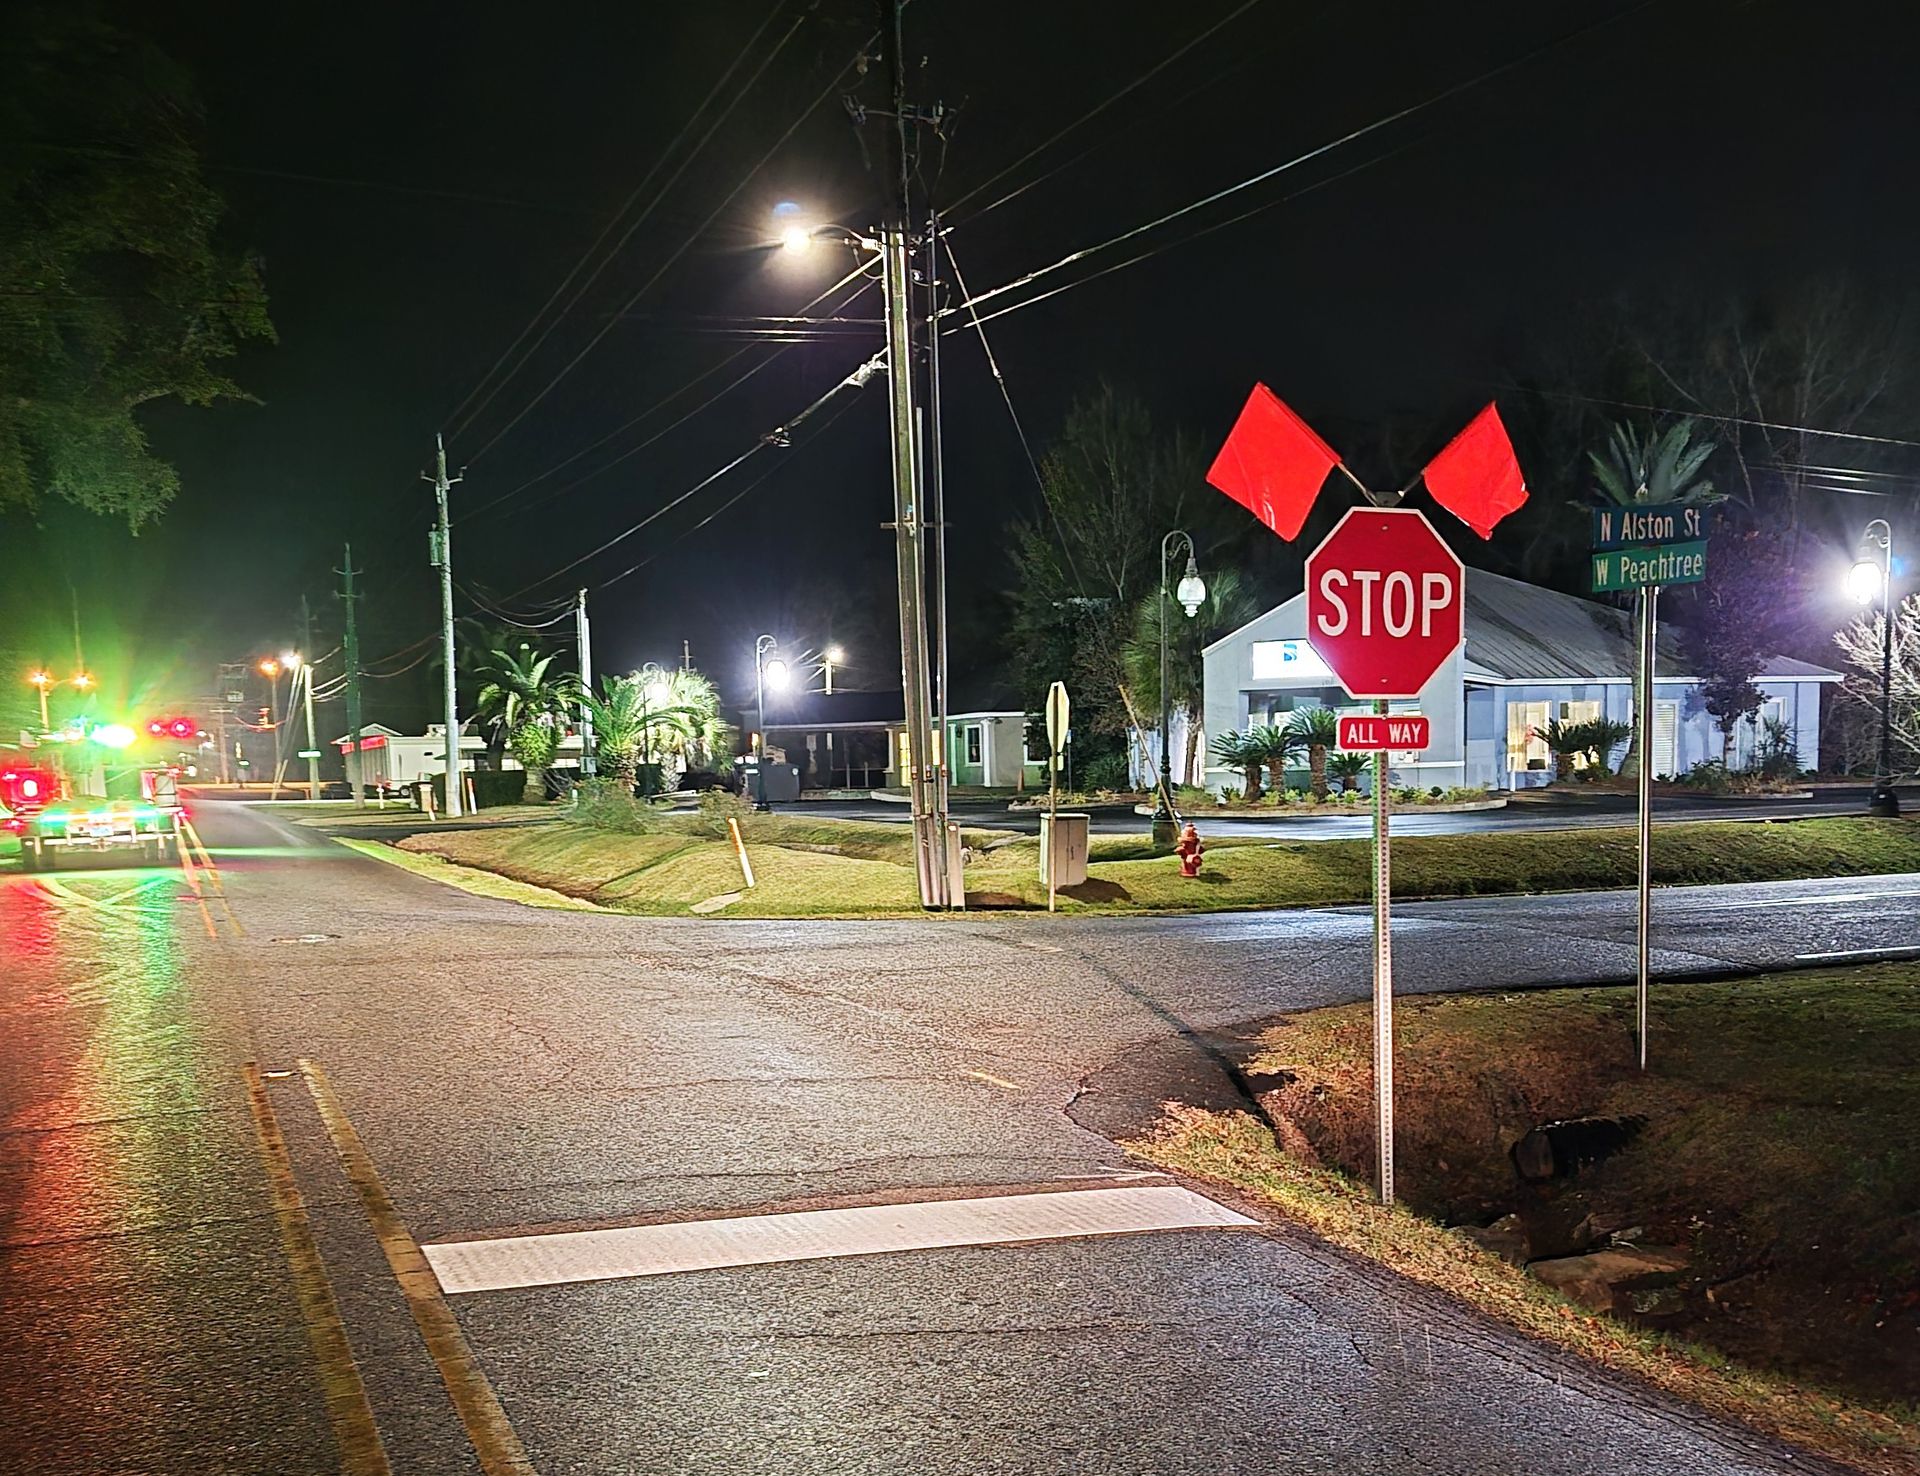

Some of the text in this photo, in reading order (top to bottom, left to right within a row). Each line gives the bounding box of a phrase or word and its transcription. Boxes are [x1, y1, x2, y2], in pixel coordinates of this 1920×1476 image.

[1601, 508, 1701, 541] N Alston St
[1597, 552, 1702, 585] W Peachtree
[1317, 569, 1452, 638] STOP
[1347, 723, 1422, 744] ALL WAY
